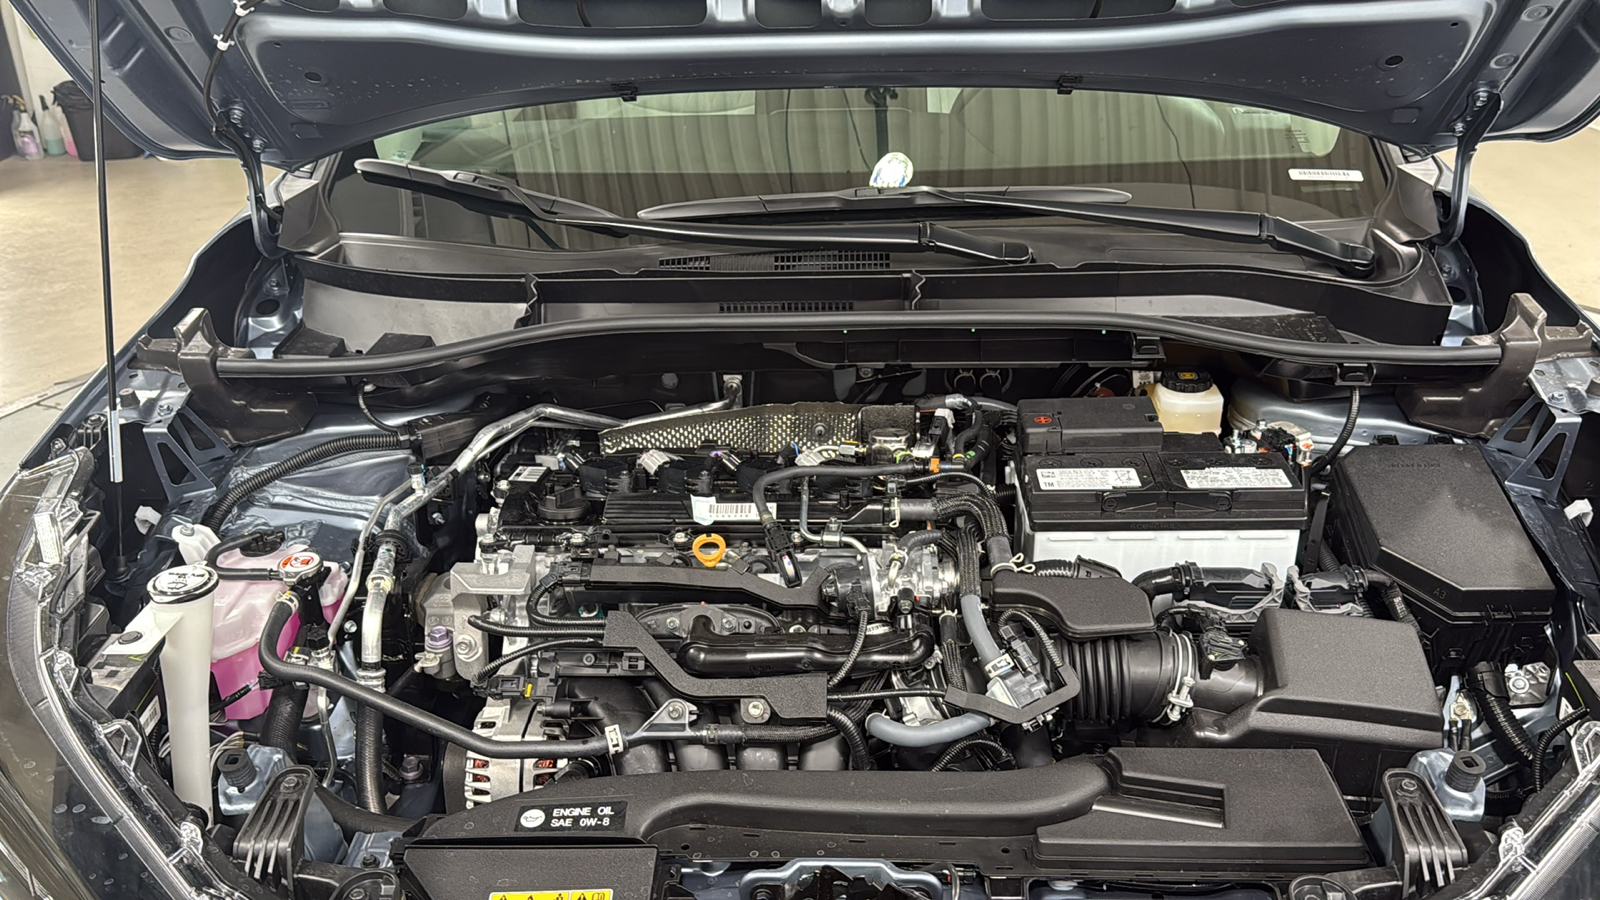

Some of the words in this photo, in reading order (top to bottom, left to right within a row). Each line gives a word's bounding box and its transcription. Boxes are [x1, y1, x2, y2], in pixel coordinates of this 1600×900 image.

[1433, 588, 1446, 599] A3
[552, 808, 591, 816] ENGINE
[597, 806, 614, 814] OIL
[551, 818, 573, 827] SAE
[579, 818, 609, 826] 0W-8
